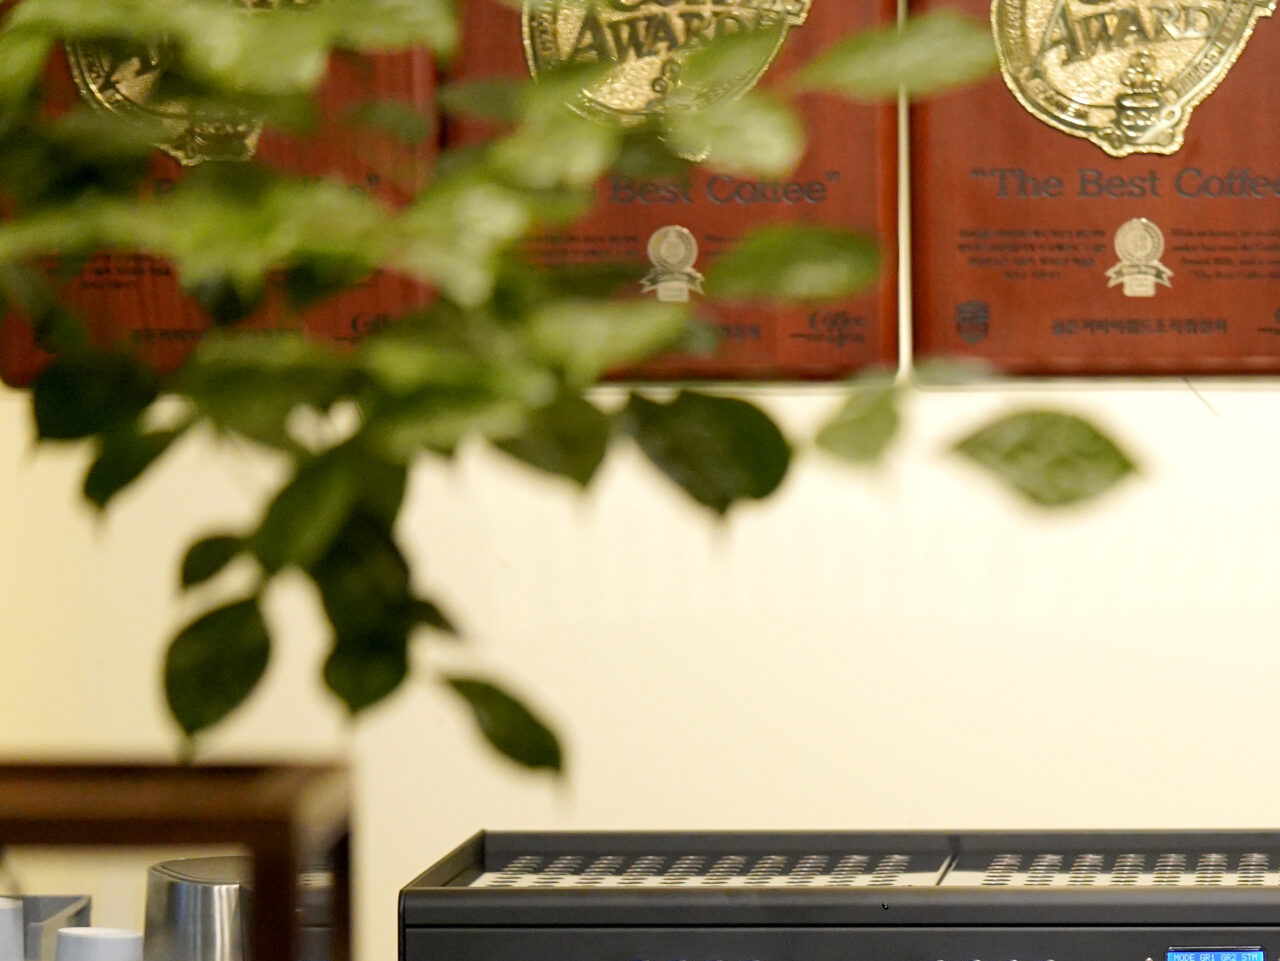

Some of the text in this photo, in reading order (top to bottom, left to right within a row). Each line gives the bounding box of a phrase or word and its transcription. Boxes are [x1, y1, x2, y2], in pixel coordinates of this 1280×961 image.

[1040, 0, 1220, 64] AWARD
[610, 175, 692, 204] Best
[1078, 168, 1161, 199] Best
[1173, 953, 1257, 961] MODE GR1 GR2 STM
